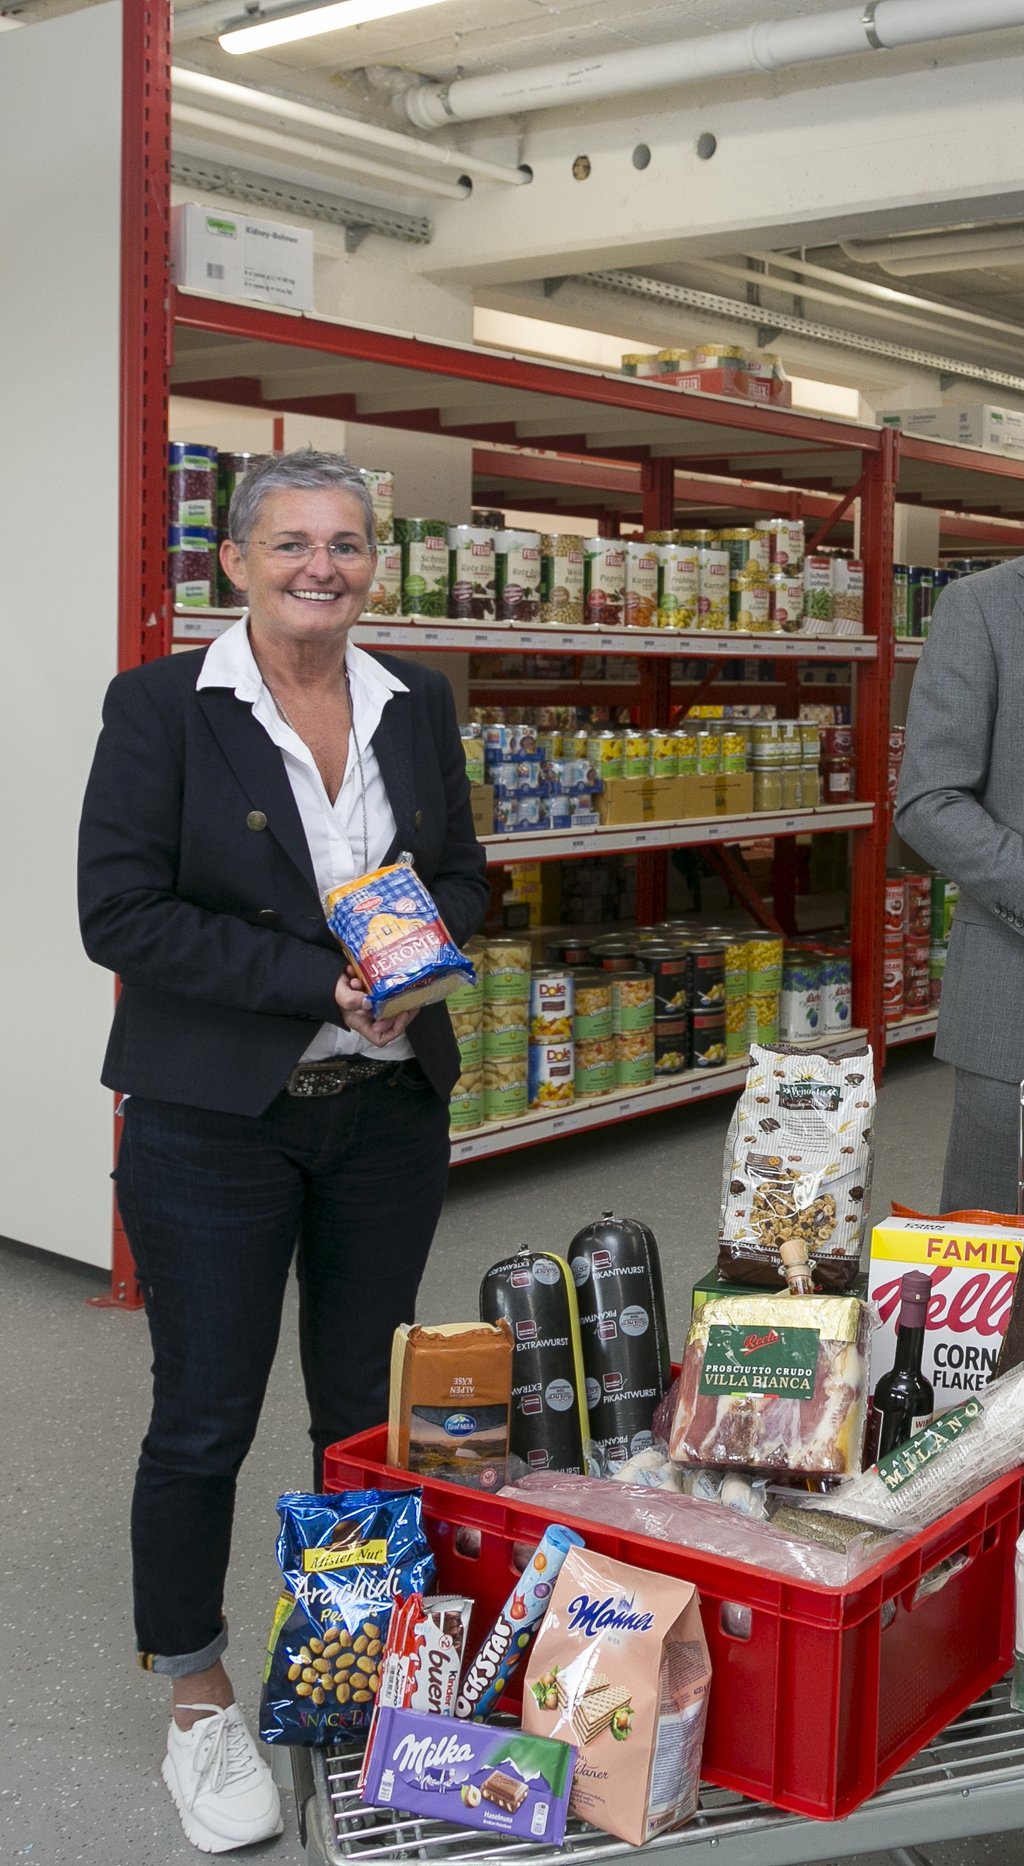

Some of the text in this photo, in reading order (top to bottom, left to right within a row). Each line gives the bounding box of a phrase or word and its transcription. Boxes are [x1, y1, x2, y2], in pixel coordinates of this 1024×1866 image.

[369, 931, 441, 978] JEROME
[539, 983, 567, 997] Dole
[547, 1047, 571, 1062] Dole
[593, 1266, 645, 1280] PIKANTWURST
[516, 1337, 569, 1352] EXTRAWURST
[933, 1343, 997, 1369] CORN
[705, 1364, 813, 1376] PROSCIUTTO CRUDO
[449, 1386, 475, 1394] ALPEN
[704, 1374, 811, 1390] VILLA BIANCA
[603, 1388, 657, 1404] PIKANTWURST
[885, 1402, 979, 1489] MILANO
[311, 1548, 380, 1569] Mister Nut
[295, 1567, 402, 1606] Arachidi
[568, 1594, 656, 1637] Manner
[445, 1670, 458, 1707] Kinder
[300, 1711, 347, 1728] SNACK
[392, 1733, 475, 1774] Milka
[483, 1811, 513, 1824] Haselnuss
